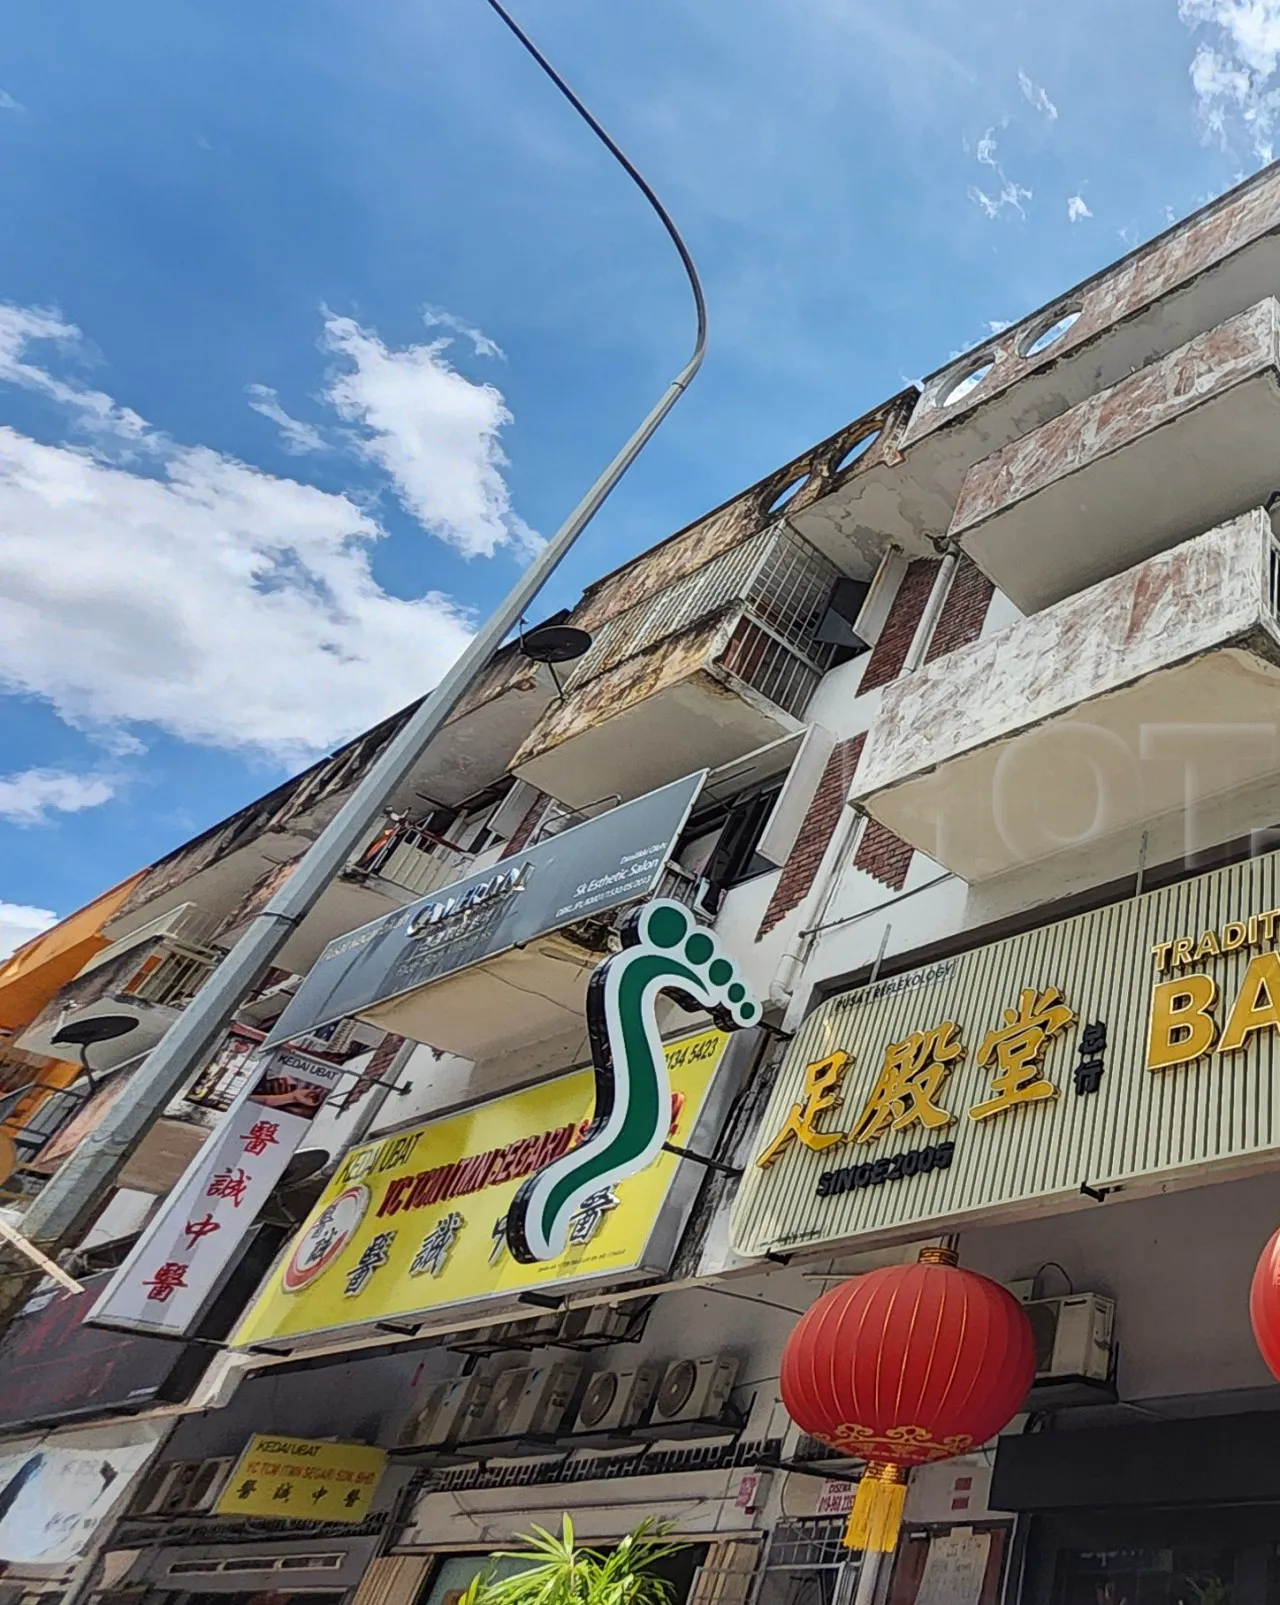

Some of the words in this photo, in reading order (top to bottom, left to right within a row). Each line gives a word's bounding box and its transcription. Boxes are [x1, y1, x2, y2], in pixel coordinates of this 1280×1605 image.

[628, 857, 660, 877] Salon
[688, 1037, 719, 1065] 5423
[278, 1054, 310, 1073] KEDAI
[311, 1064, 339, 1081] UBAT
[755, 986, 1080, 1170] 足殿堂
[335, 1138, 381, 1185] KEDAI
[379, 1131, 425, 1171] UBAT
[256, 1439, 290, 1454] KEDAI
[291, 1443, 321, 1457] UBAT
